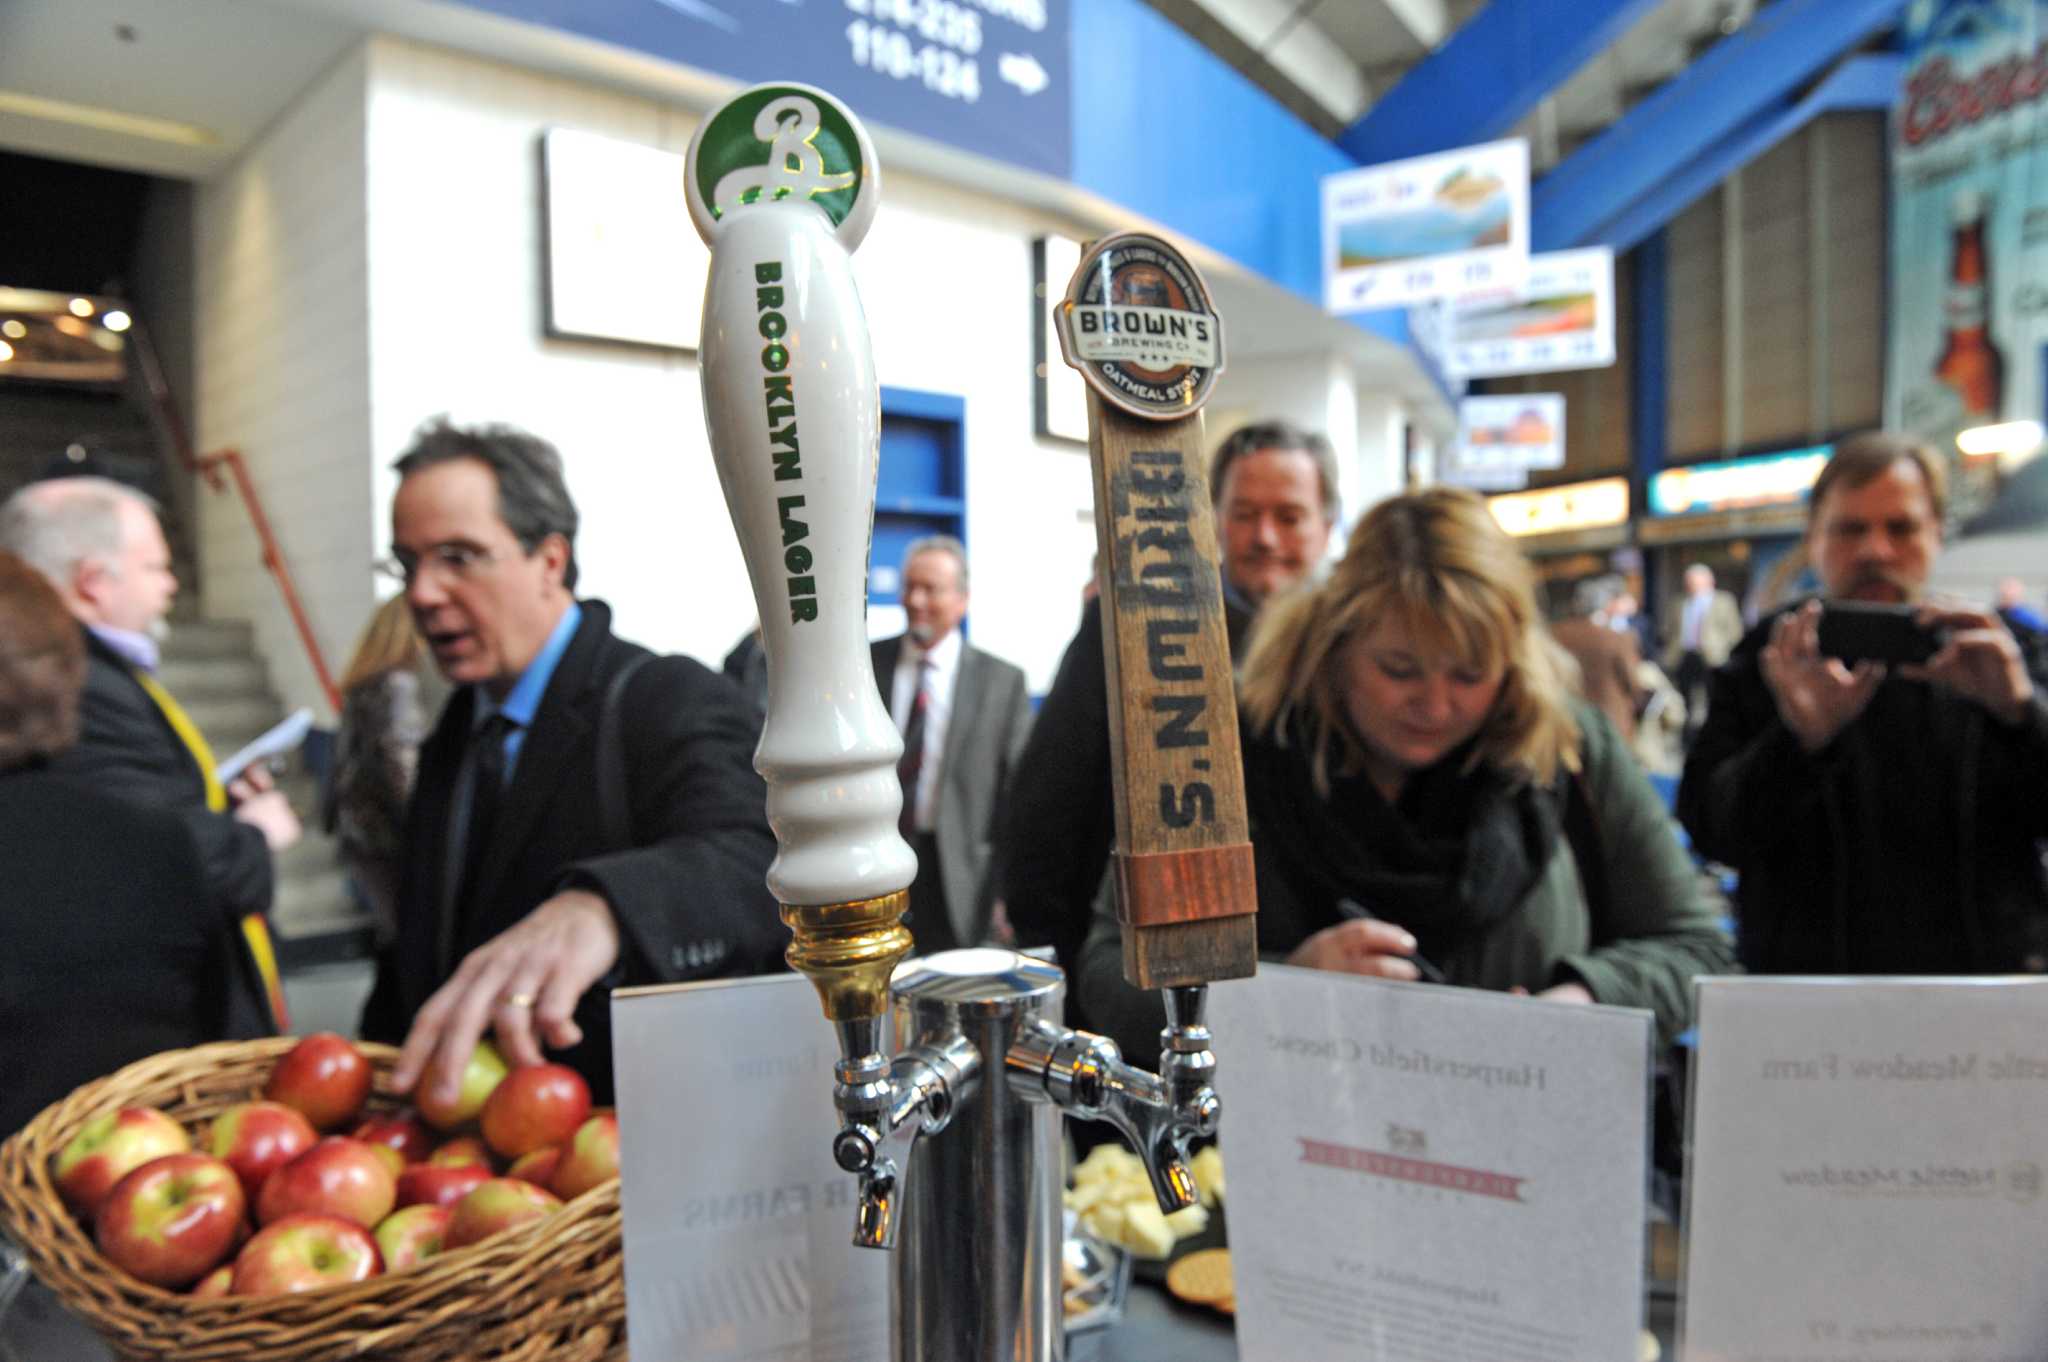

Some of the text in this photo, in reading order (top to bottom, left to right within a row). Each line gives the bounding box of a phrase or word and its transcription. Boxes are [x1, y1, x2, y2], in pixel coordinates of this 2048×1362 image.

[1080, 311, 1208, 342] BROWN'S
[1102, 362, 1166, 401] OATMEAL
[755, 262, 818, 625] BROOKLYN LAGER
